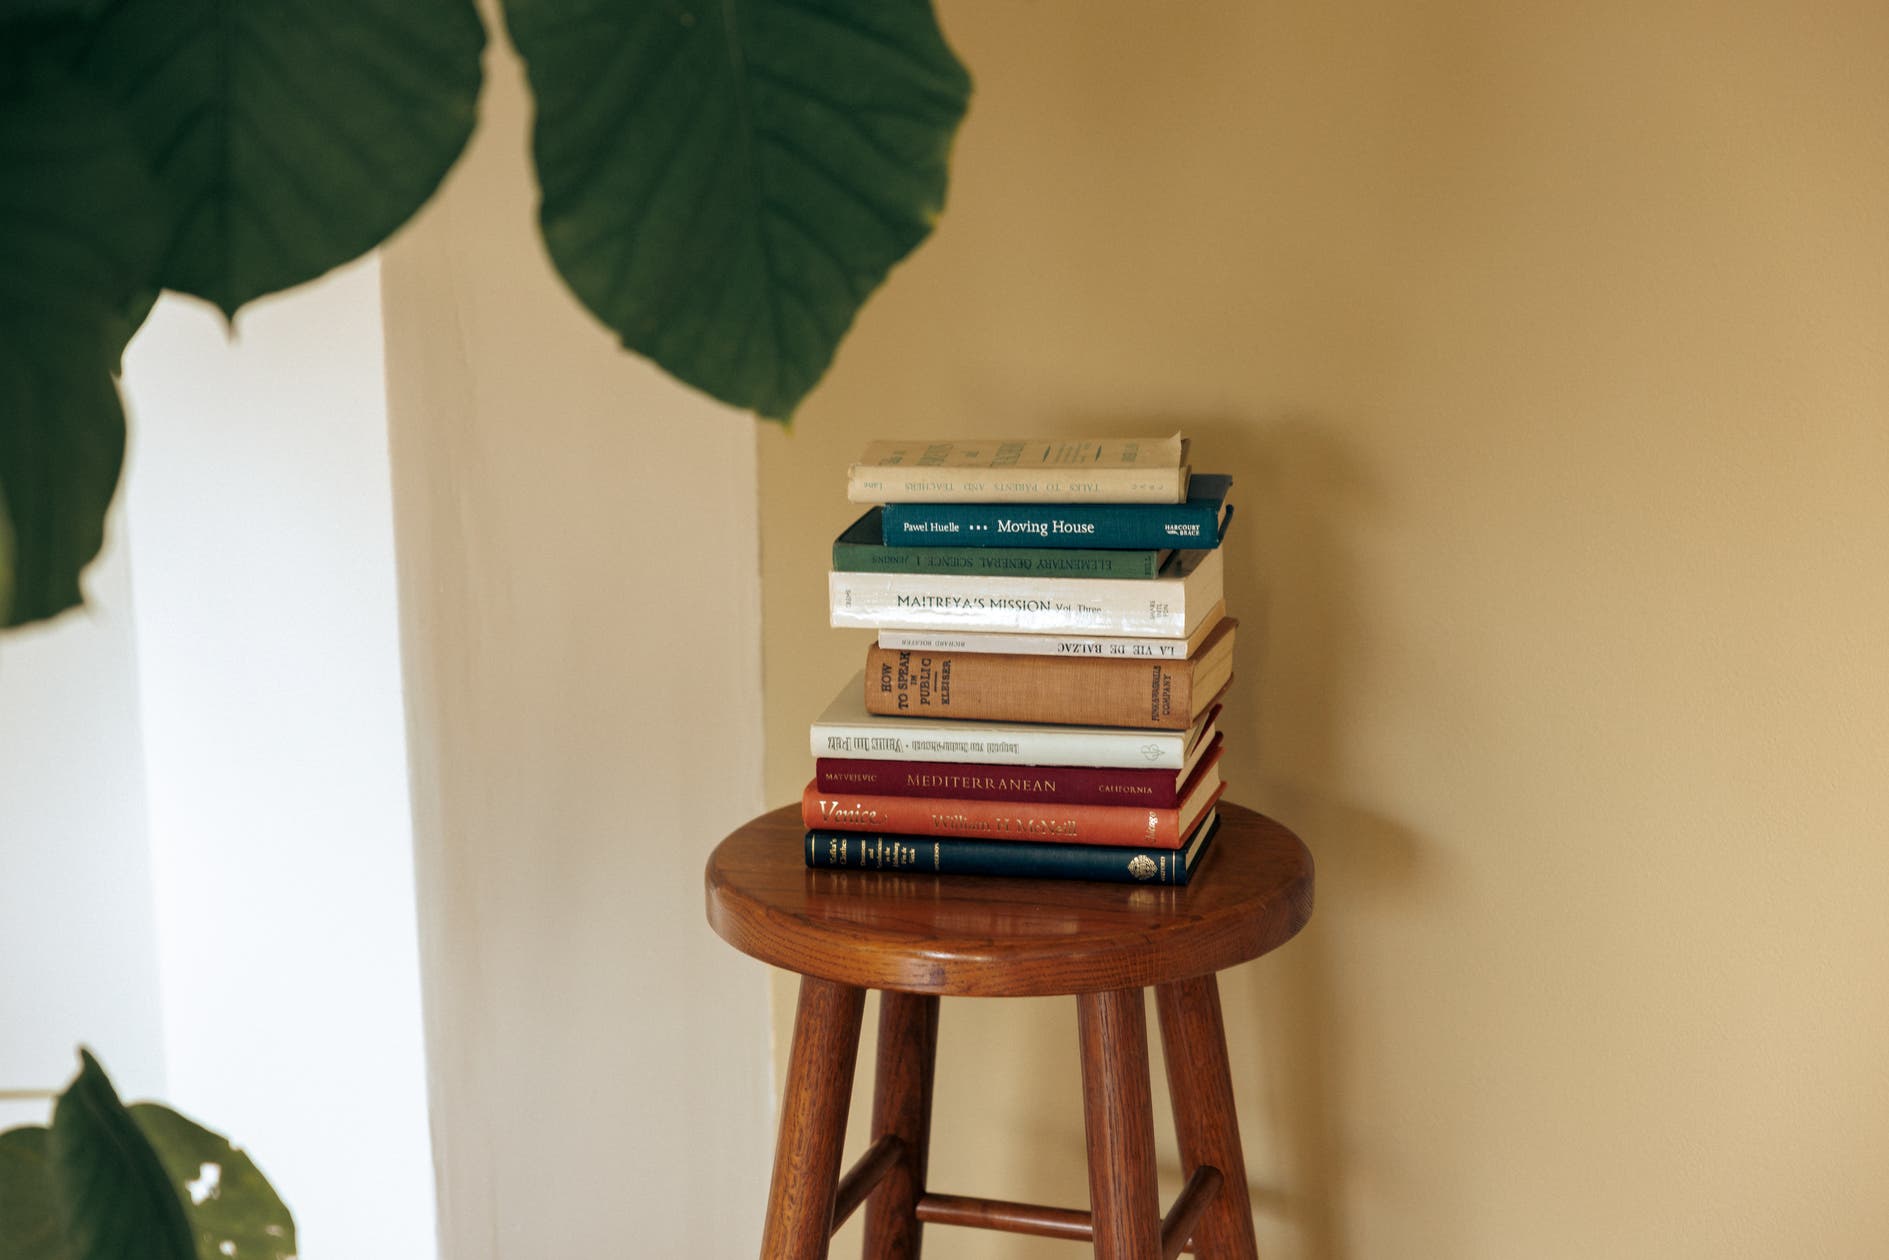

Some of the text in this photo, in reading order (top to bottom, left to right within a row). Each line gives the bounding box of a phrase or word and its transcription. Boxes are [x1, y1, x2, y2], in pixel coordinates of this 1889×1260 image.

[905, 482, 1098, 492] TALKS TO PARENTS AND TEACHERS
[903, 522, 960, 532] Pawel Huelle
[997, 519, 1095, 537] Moving House
[928, 556, 973, 568] SCIENCE
[981, 557, 1032, 570] GENERAL
[1036, 559, 1112, 571] ELEMENTARY
[897, 595, 985, 609] MAITREYA'S
[990, 599, 1051, 613] MISSION
[1078, 604, 1102, 613] Three
[1057, 642, 1175, 656] LA VIE DE BALZAC
[881, 663, 892, 692] HOW
[898, 651, 911, 710] TO SPEAK
[920, 658, 932, 705] PUBLIC
[941, 660, 952, 705] KLEISER
[1162, 673, 1171, 716] COMPANY
[907, 774, 1057, 792] MEDITERRANEAN
[1099, 785, 1153, 794] CALIFORNIA
[819, 800, 879, 824] Venice
[931, 814, 991, 832] William
[1016, 819, 1077, 836] McNeill
